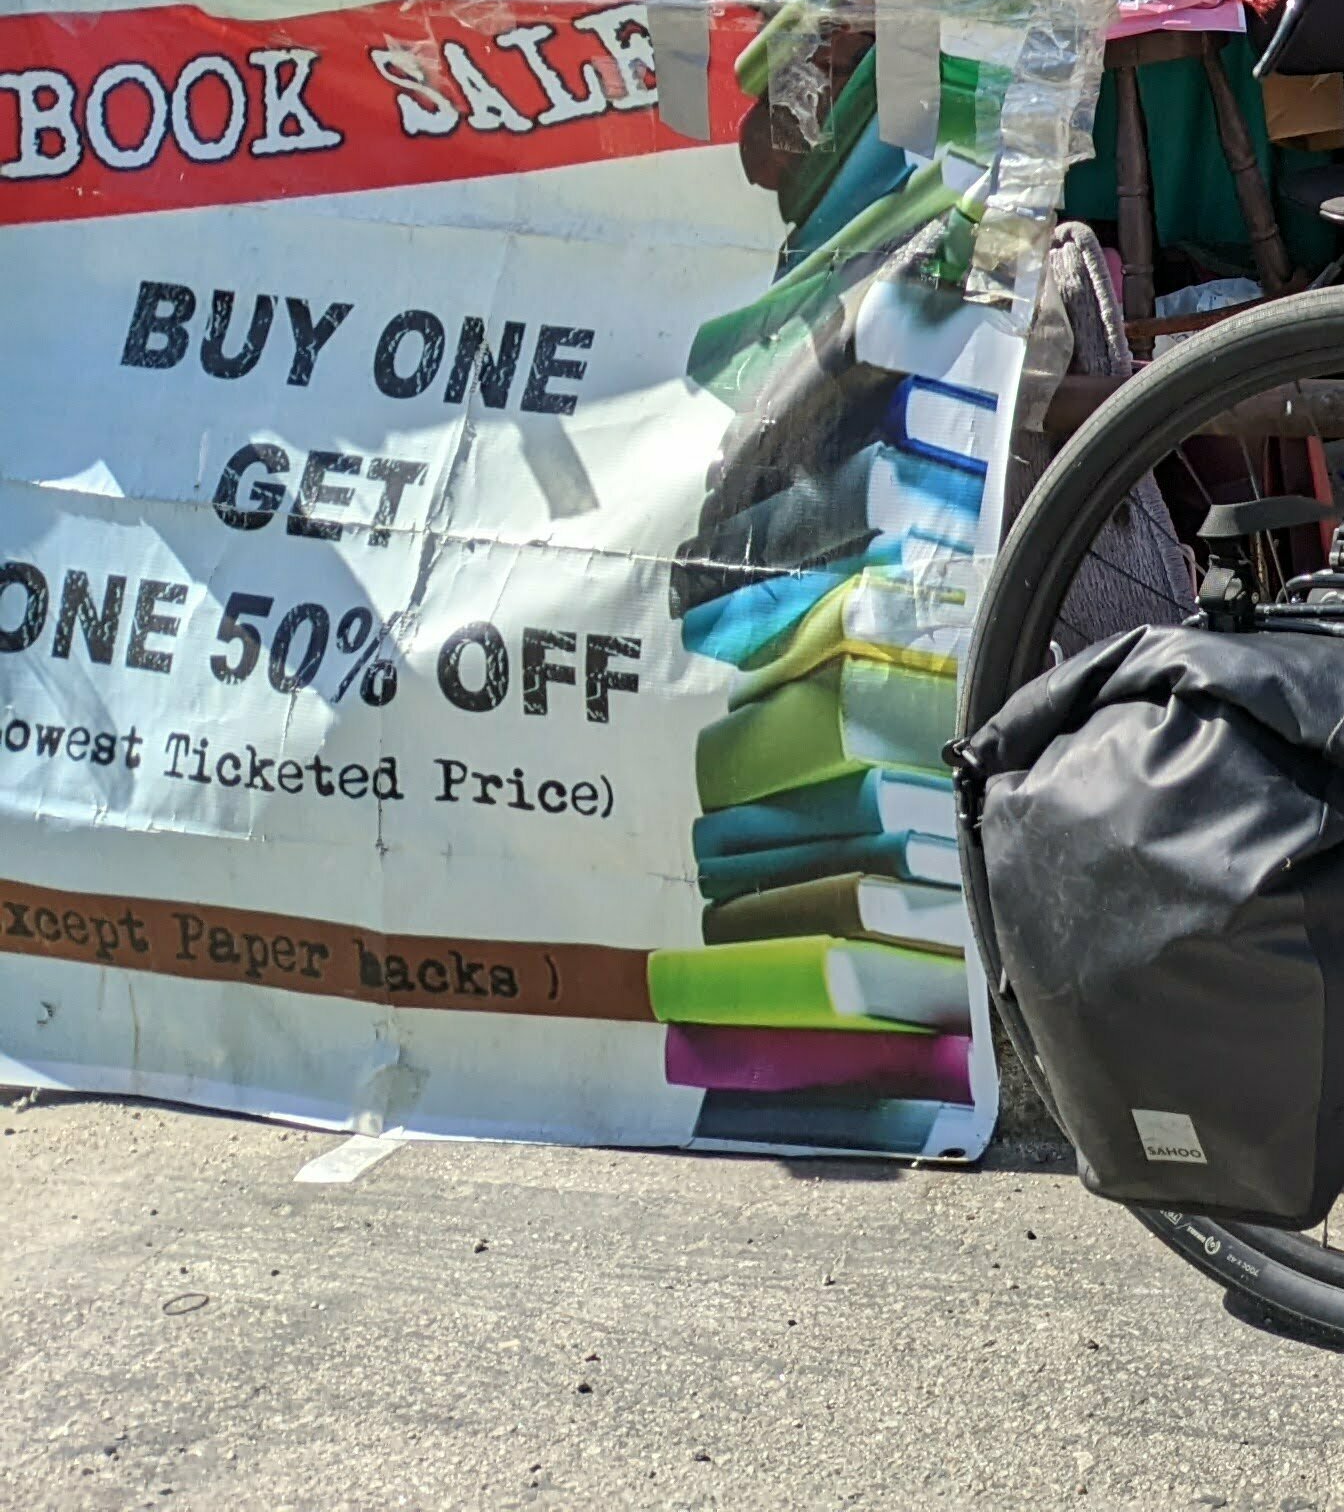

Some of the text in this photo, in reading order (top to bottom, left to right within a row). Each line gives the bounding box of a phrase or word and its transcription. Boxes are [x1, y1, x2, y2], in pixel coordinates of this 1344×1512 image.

[0, 2, 662, 180] BOOK SALE
[120, 280, 596, 417] BUY ONE
[212, 442, 432, 547] GET
[0, 561, 644, 725] ONE 50% OFF
[0, 718, 616, 819] owest Ticketed Price)
[0, 900, 149, 961] xcept
[171, 910, 330, 979] Paper
[1147, 1146, 1202, 1158] SAHOO
